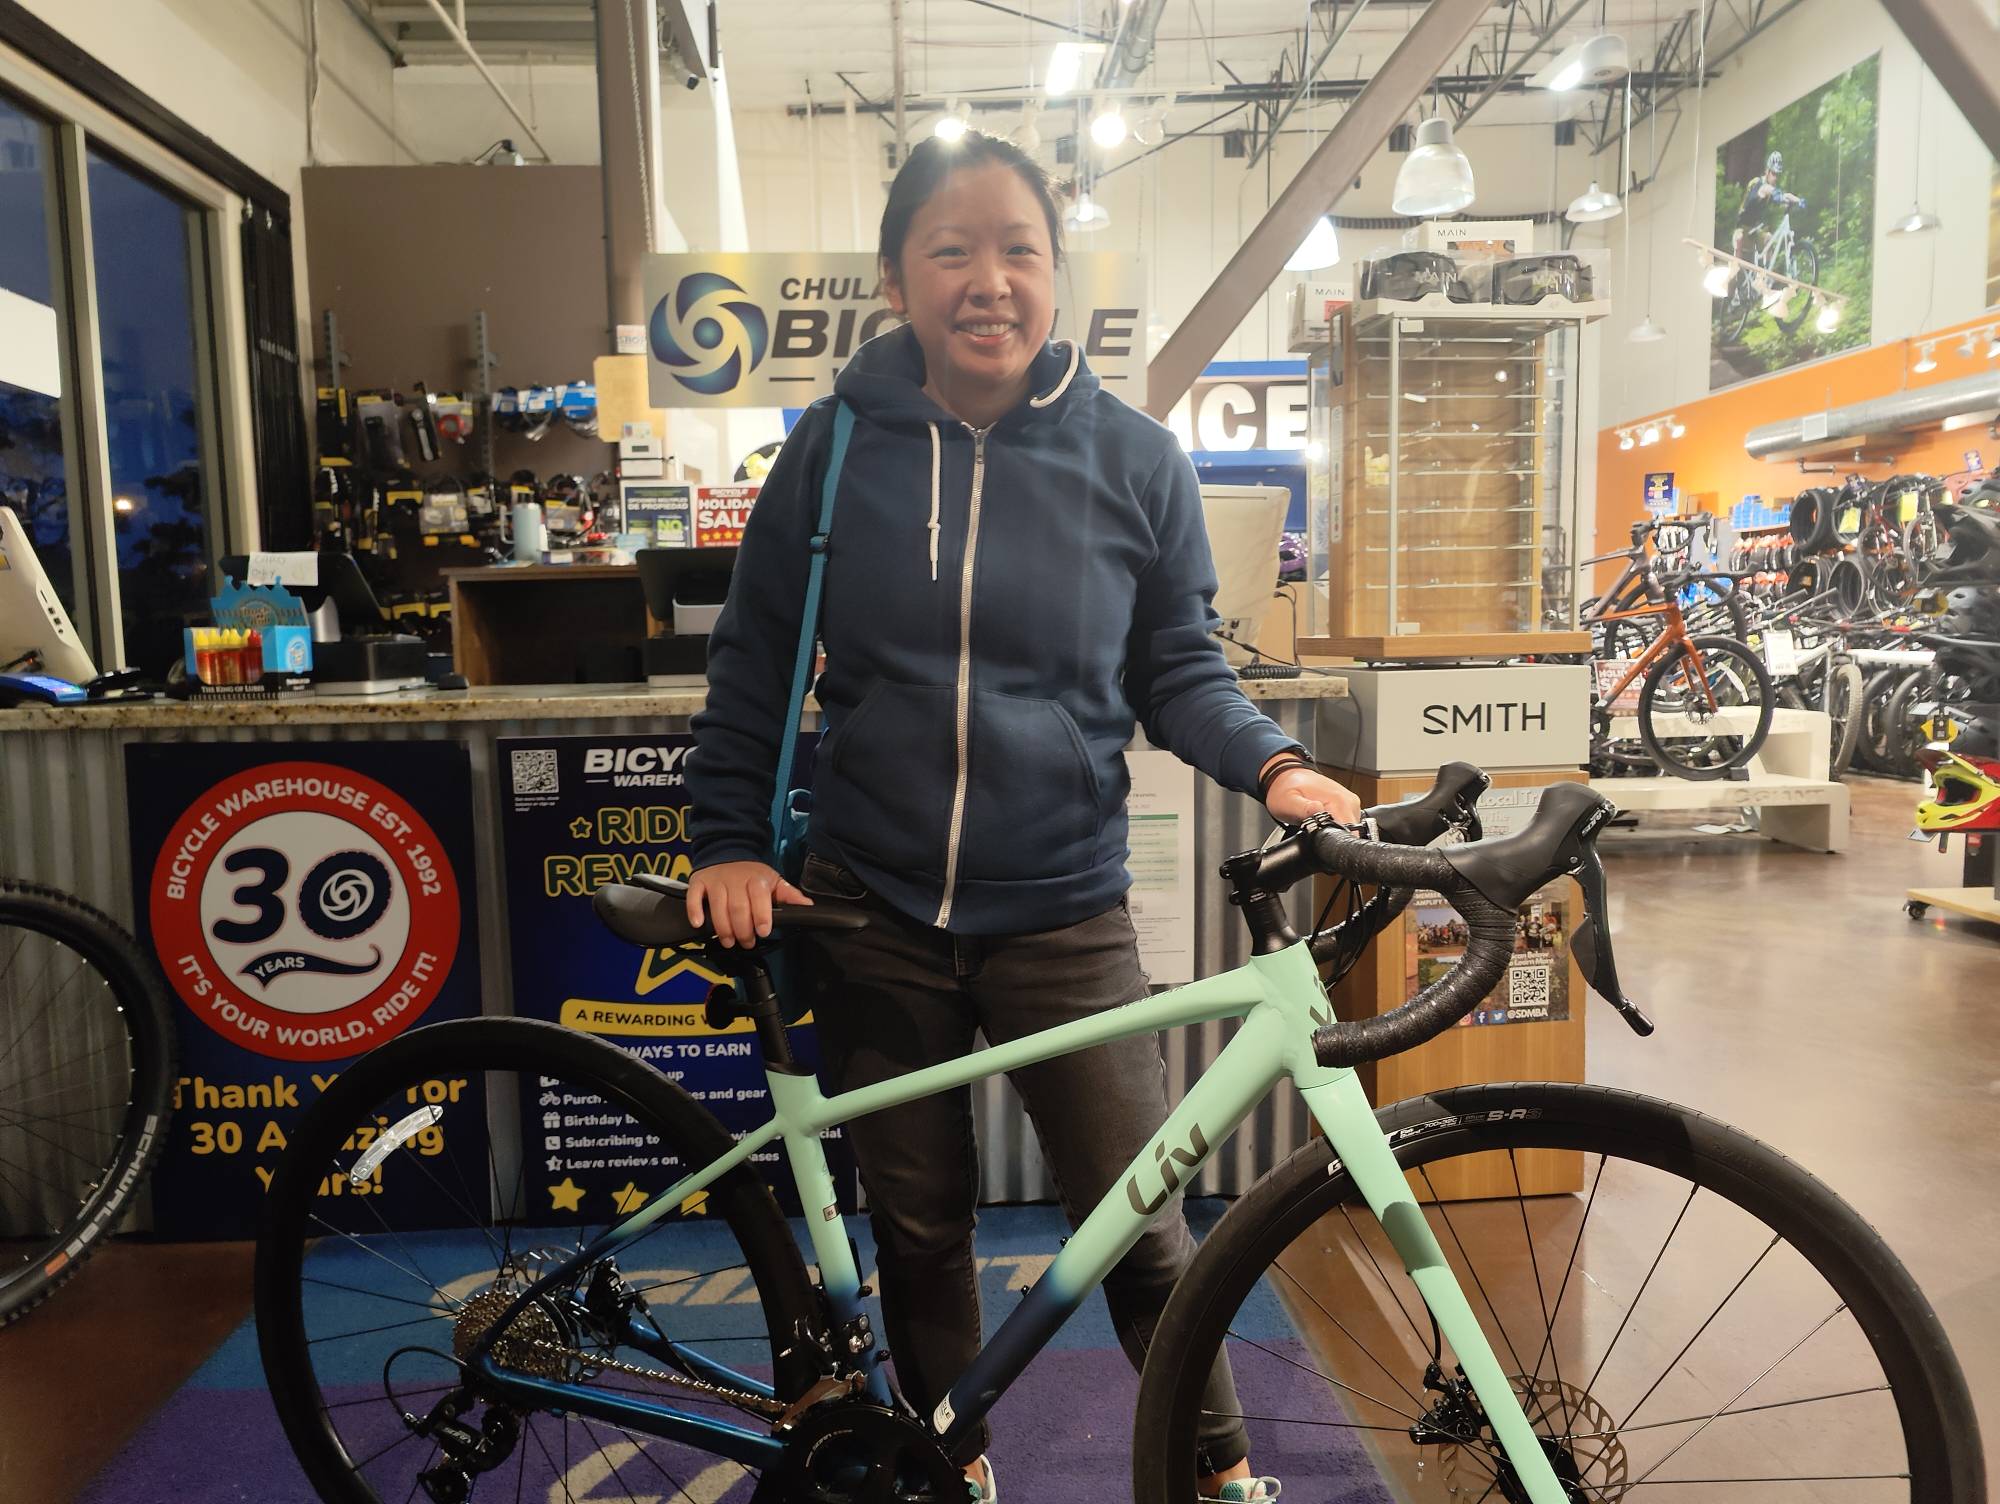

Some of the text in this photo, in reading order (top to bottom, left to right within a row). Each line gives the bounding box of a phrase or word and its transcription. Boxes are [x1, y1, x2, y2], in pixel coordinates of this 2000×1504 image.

[1437, 228, 1467, 237] MAIN
[1315, 288, 1345, 296] MAIN
[1422, 701, 1546, 735] SMITH
[584, 747, 695, 773] BICY
[614, 774, 686, 787] WAREH
[166, 777, 442, 901] BICYCLE WAREHOUSE EST. 1992
[211, 847, 394, 944] 30
[254, 955, 306, 979] YEARS
[177, 951, 439, 1047] IT'S YOUR WORLD, RIDE IT!
[576, 1009, 588, 1021] A
[593, 1012, 696, 1026] REWARDING
[1507, 1008, 1549, 1019] @SDMBA
[677, 1045, 701, 1058] TO
[705, 1043, 751, 1056] EARN
[667, 1071, 684, 1081] up
[172, 1075, 299, 1110] Thank
[563, 1093, 608, 1105] Purch
[709, 1088, 733, 1099] and
[736, 1089, 767, 1101] gear
[564, 1113, 622, 1127] Birthday
[190, 1121, 243, 1154] 30
[565, 1134, 661, 1148] Subscribing to
[566, 1159, 605, 1169] Leave
[661, 1156, 679, 1165] on
[1126, 1122, 1209, 1216] Liv
